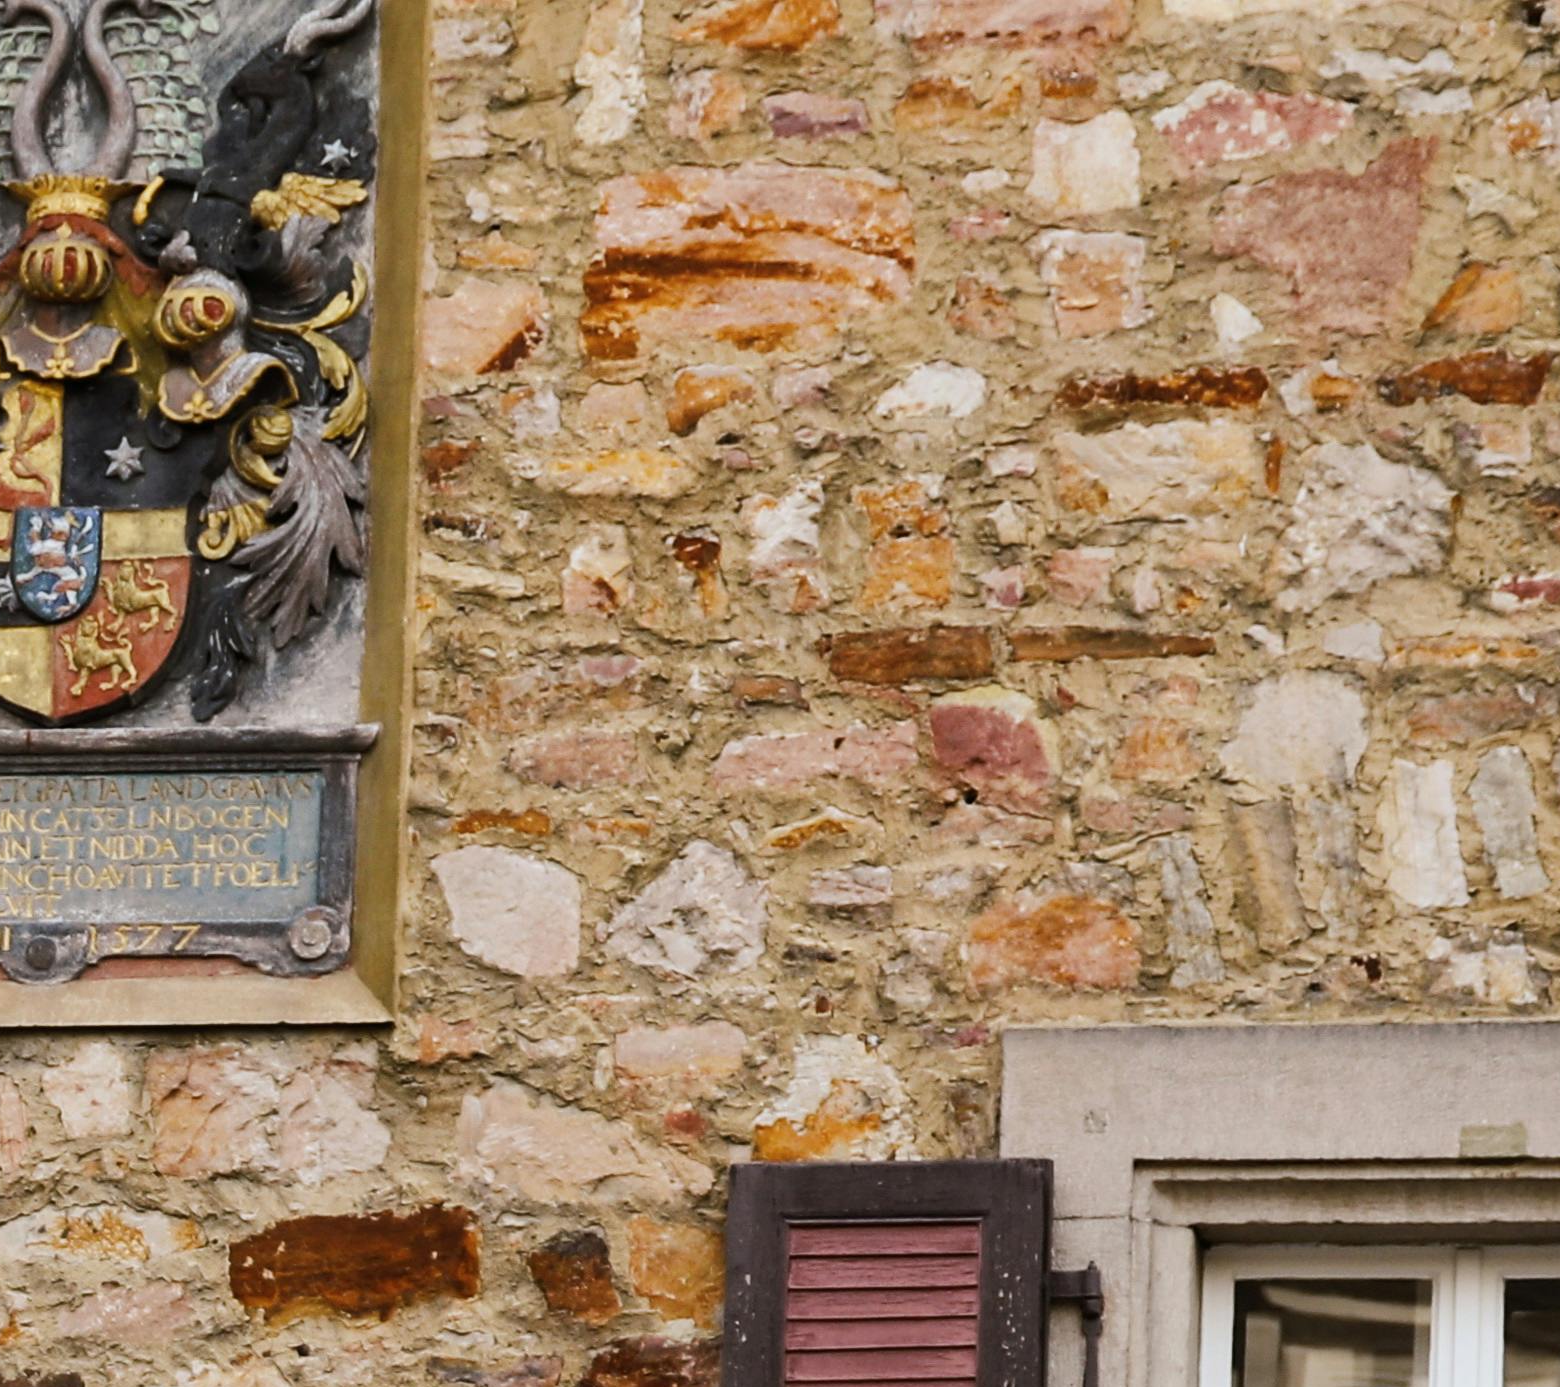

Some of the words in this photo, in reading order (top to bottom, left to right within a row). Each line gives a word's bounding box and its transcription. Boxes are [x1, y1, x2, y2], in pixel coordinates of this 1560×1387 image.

[90, 834, 179, 860] NIDDA
[193, 832, 267, 858] HOC
[87, 924, 201, 954] 1577
